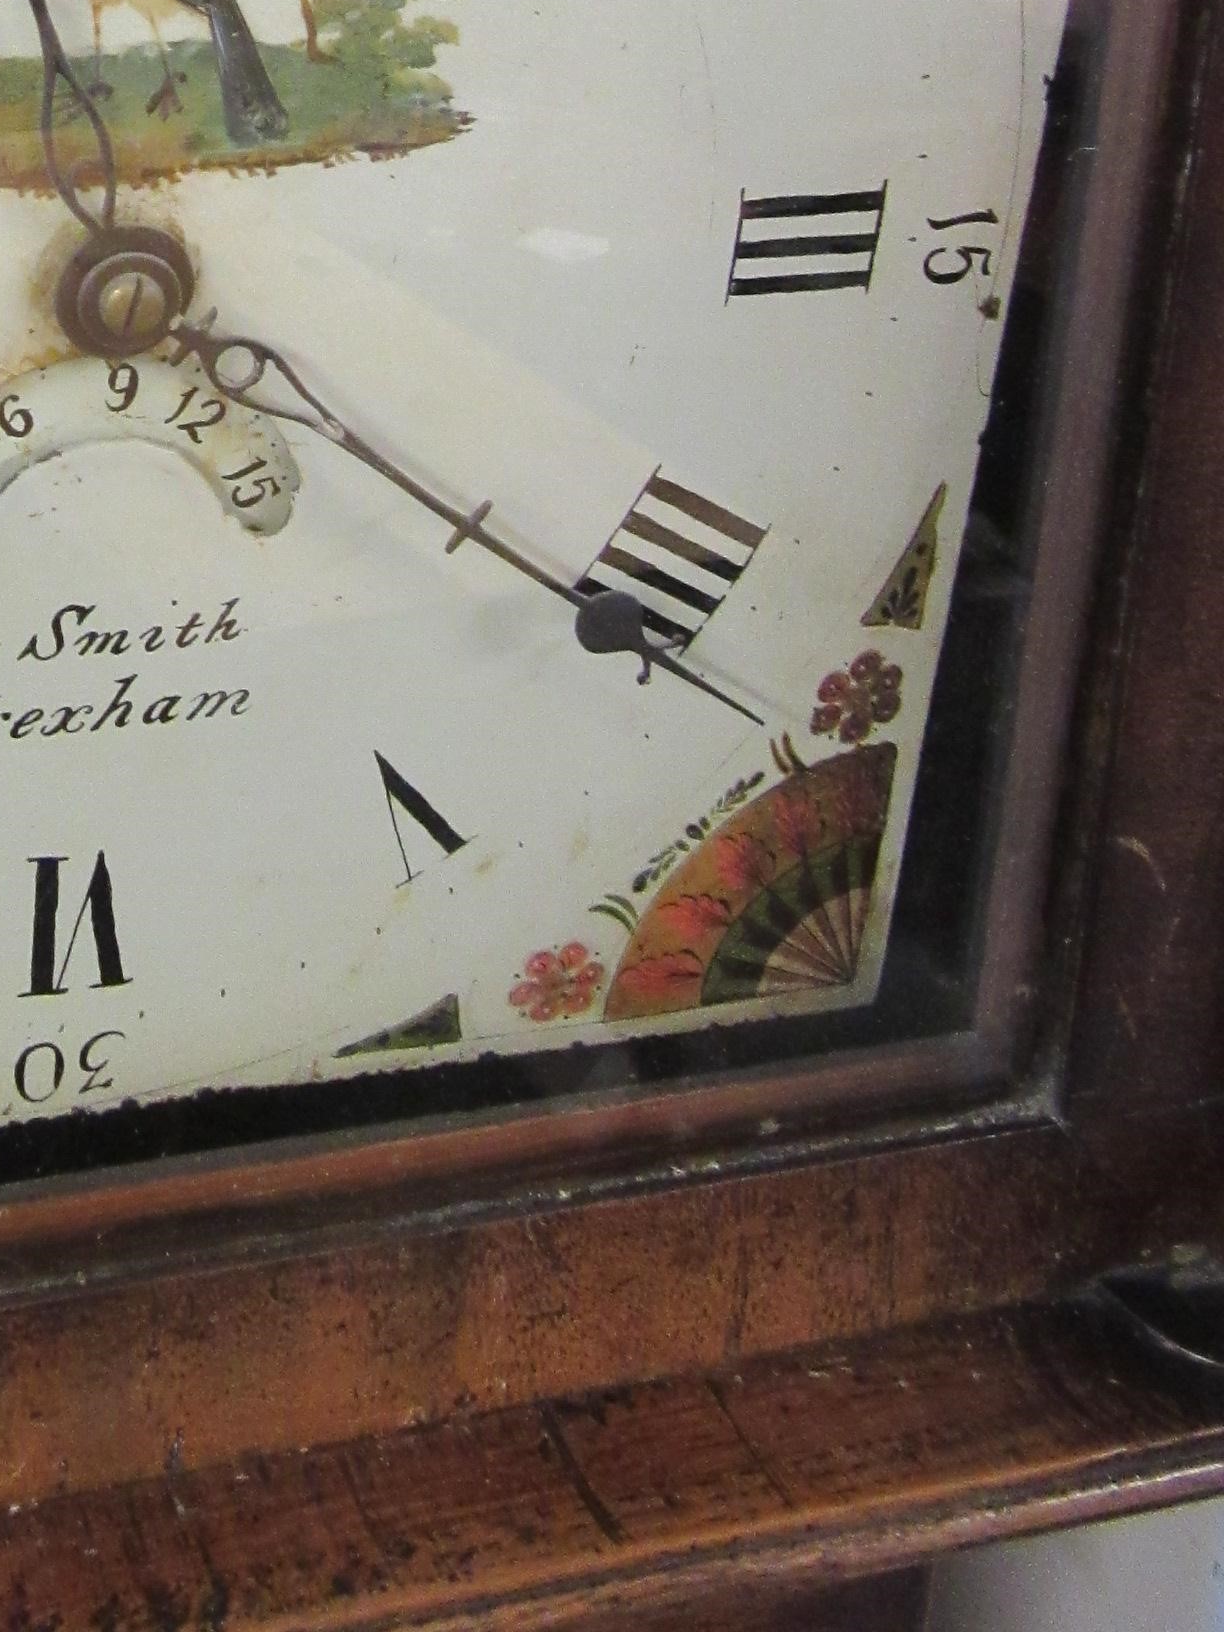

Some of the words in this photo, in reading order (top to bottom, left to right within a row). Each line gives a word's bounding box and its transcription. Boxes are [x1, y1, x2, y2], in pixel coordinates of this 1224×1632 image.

[724, 179, 888, 306] III
[923, 207, 1000, 285] 15
[104, 363, 139, 412] 9
[164, 386, 226, 444] 12
[221, 456, 281, 508] 15
[17, 597, 240, 661] Smith
[374, 749, 479, 888] V
[17, 850, 133, 998] VI
[13, 1030, 126, 1103] 30
